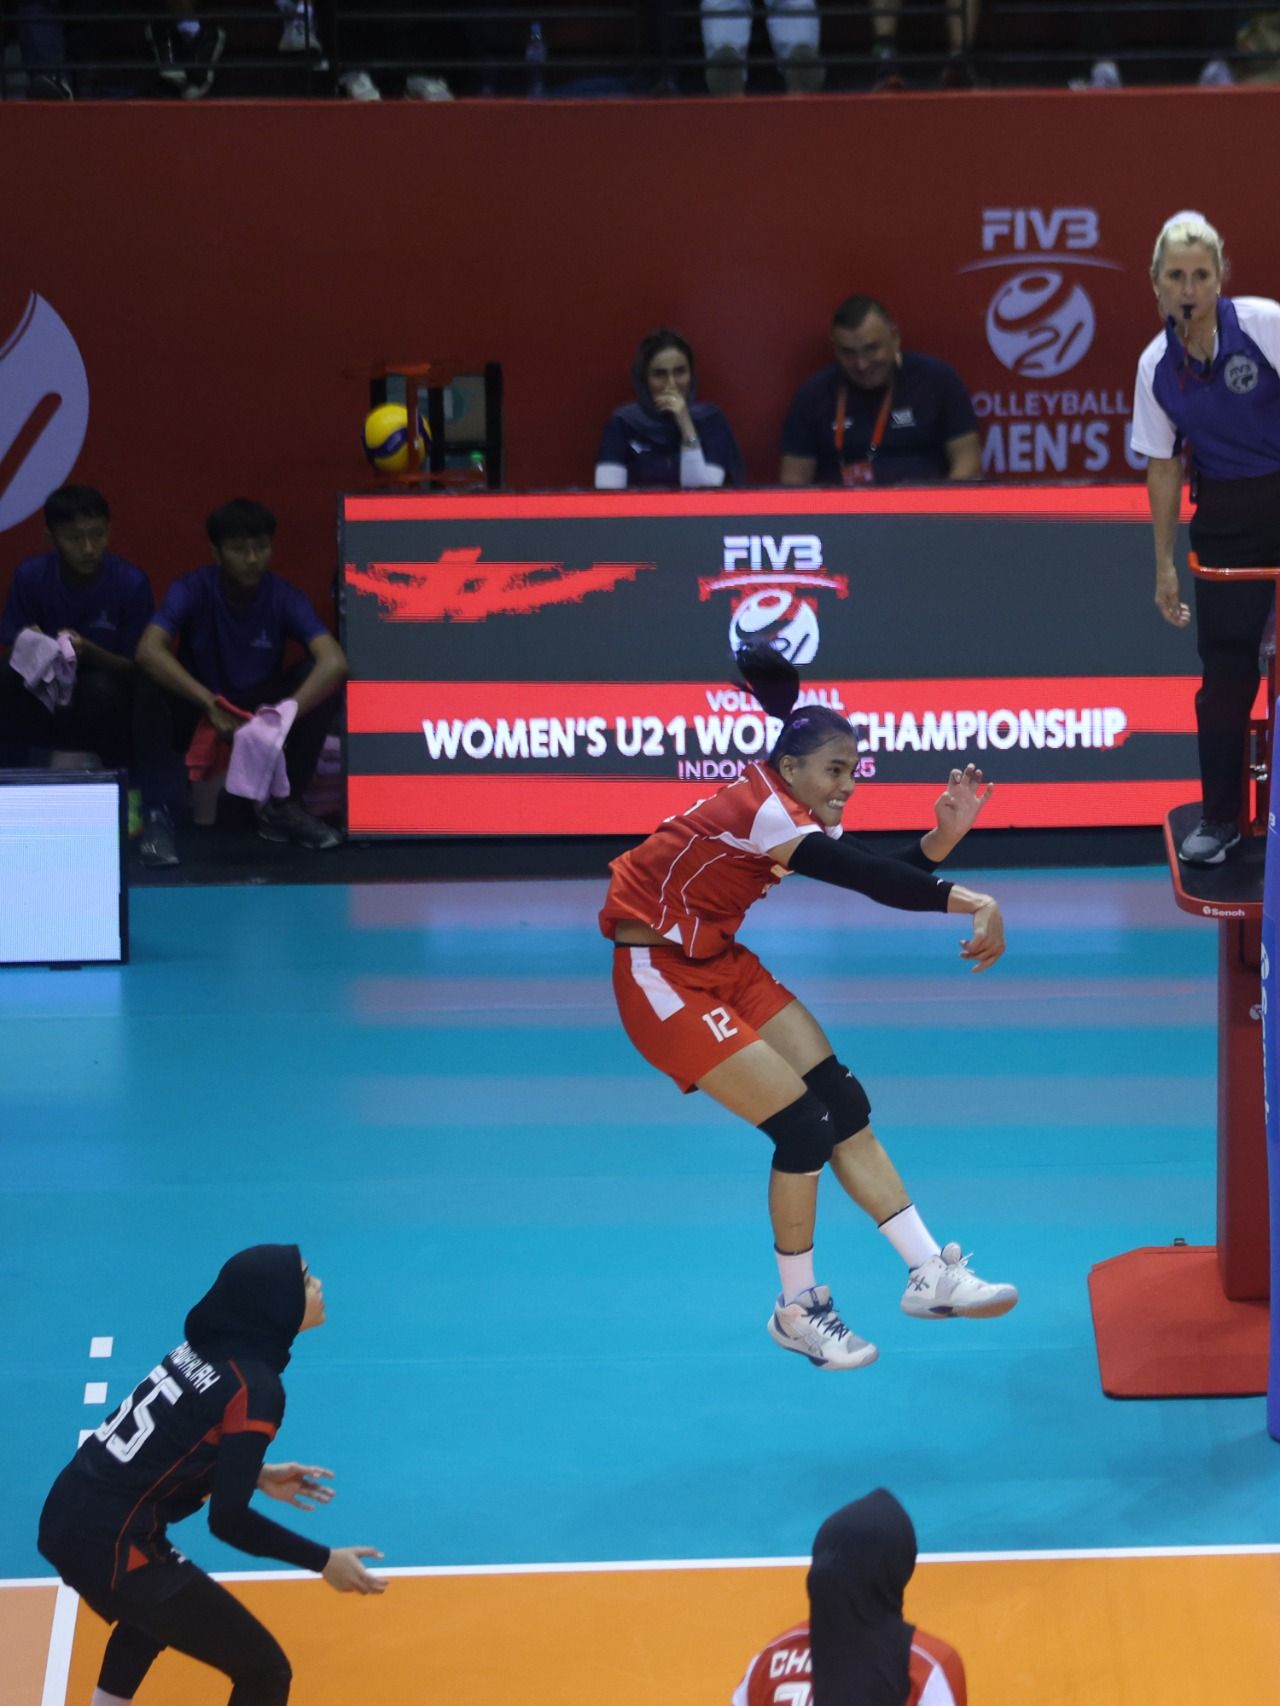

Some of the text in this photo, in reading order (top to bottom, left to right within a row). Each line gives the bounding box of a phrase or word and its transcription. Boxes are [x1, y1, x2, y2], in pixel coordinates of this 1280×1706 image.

[982, 207, 1099, 251] FIVB
[971, 390, 1132, 417] OLLEYBALL
[723, 534, 823, 571] FIVB
[422, 706, 1128, 760] WOMEN'S U21 WOR CHAMPIONSHIP
[1212, 908, 1246, 917] Senoh
[701, 1006, 738, 1043] 12
